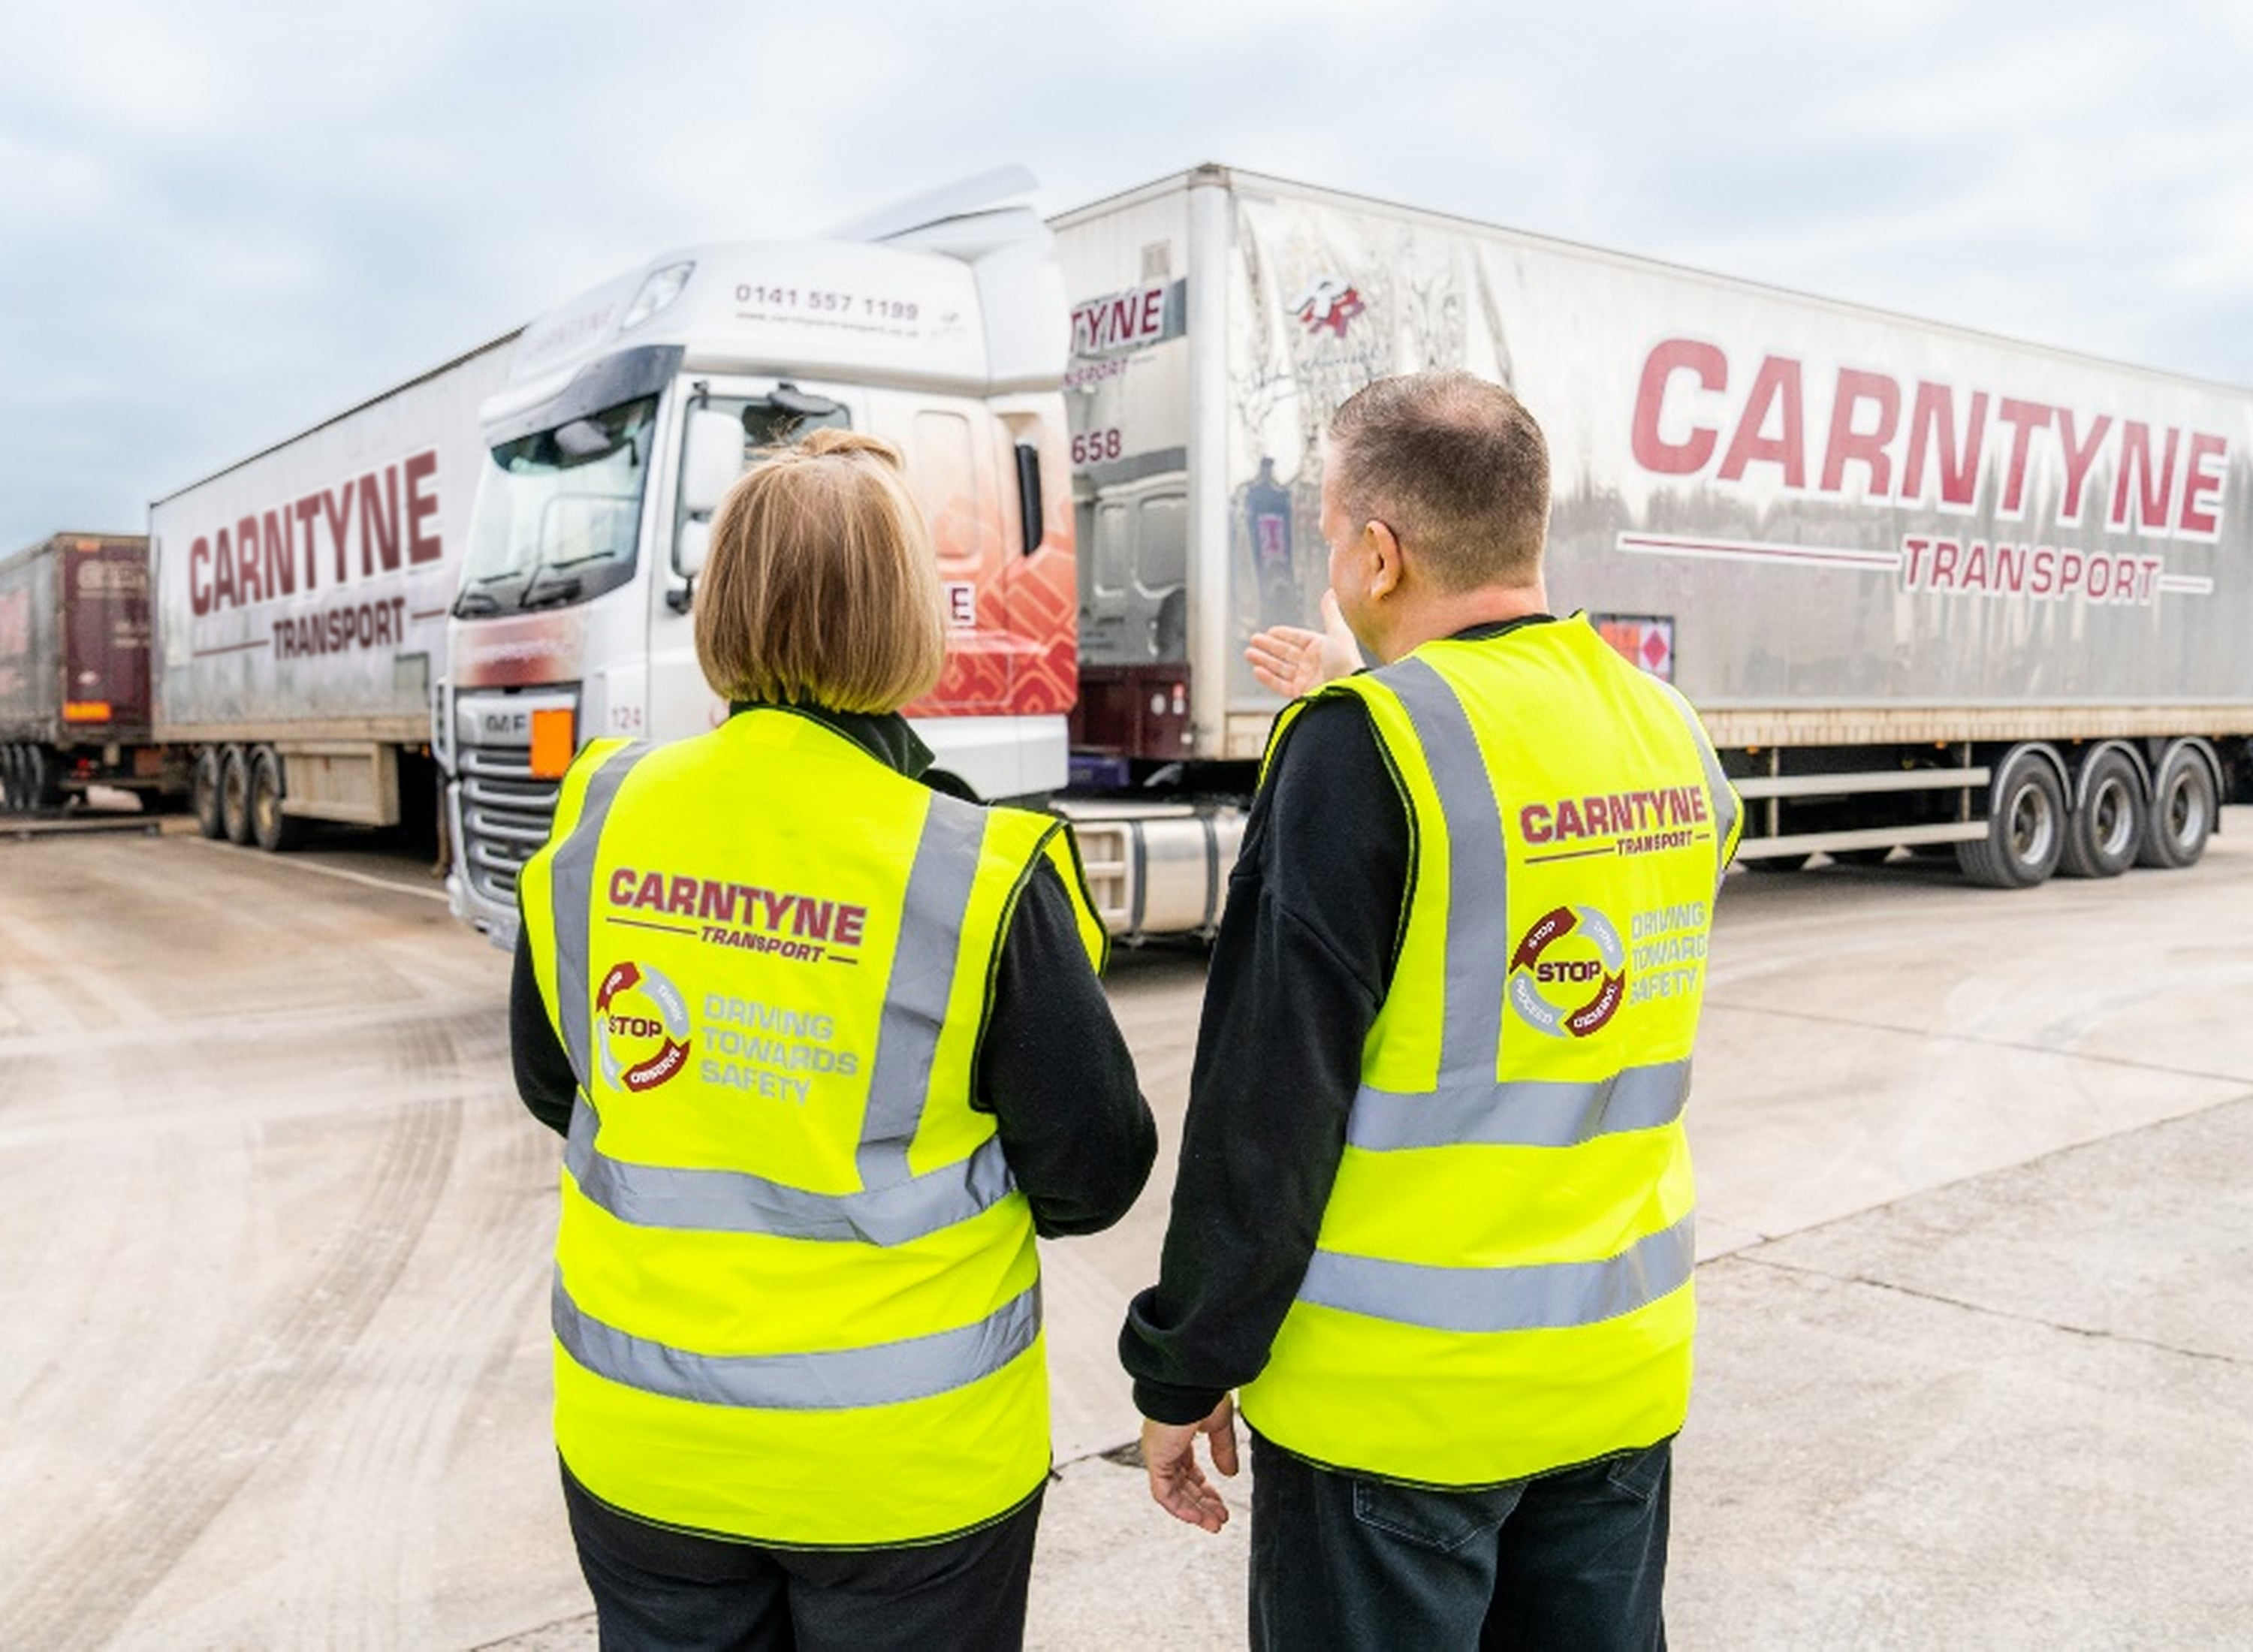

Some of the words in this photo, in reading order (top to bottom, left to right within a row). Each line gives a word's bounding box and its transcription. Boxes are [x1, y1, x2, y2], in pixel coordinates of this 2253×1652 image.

[735, 284, 798, 306] 0141
[809, 291, 852, 312] 557
[864, 297, 919, 321] 1199
[1072, 428, 1121, 464] 658
[1630, 338, 2228, 535] CARNTYNE
[189, 449, 443, 618] CARNTYNE
[1905, 539, 2160, 600] TRANSPORT
[273, 596, 406, 662] TRANSPORT
[1520, 785, 1709, 844] CARNTYNE
[1617, 830, 1694, 857] TRANSPORT
[608, 867, 867, 947] CARNTYNE
[1631, 900, 1706, 940] DRIVING
[701, 925, 825, 963] TRANSPORT
[1536, 960, 1602, 983] STOP
[608, 1014, 662, 1038] STOP
[704, 992, 835, 1042] DRIVING
[702, 1025, 859, 1076] TOWARDS
[700, 1058, 811, 1107] SAFETY
